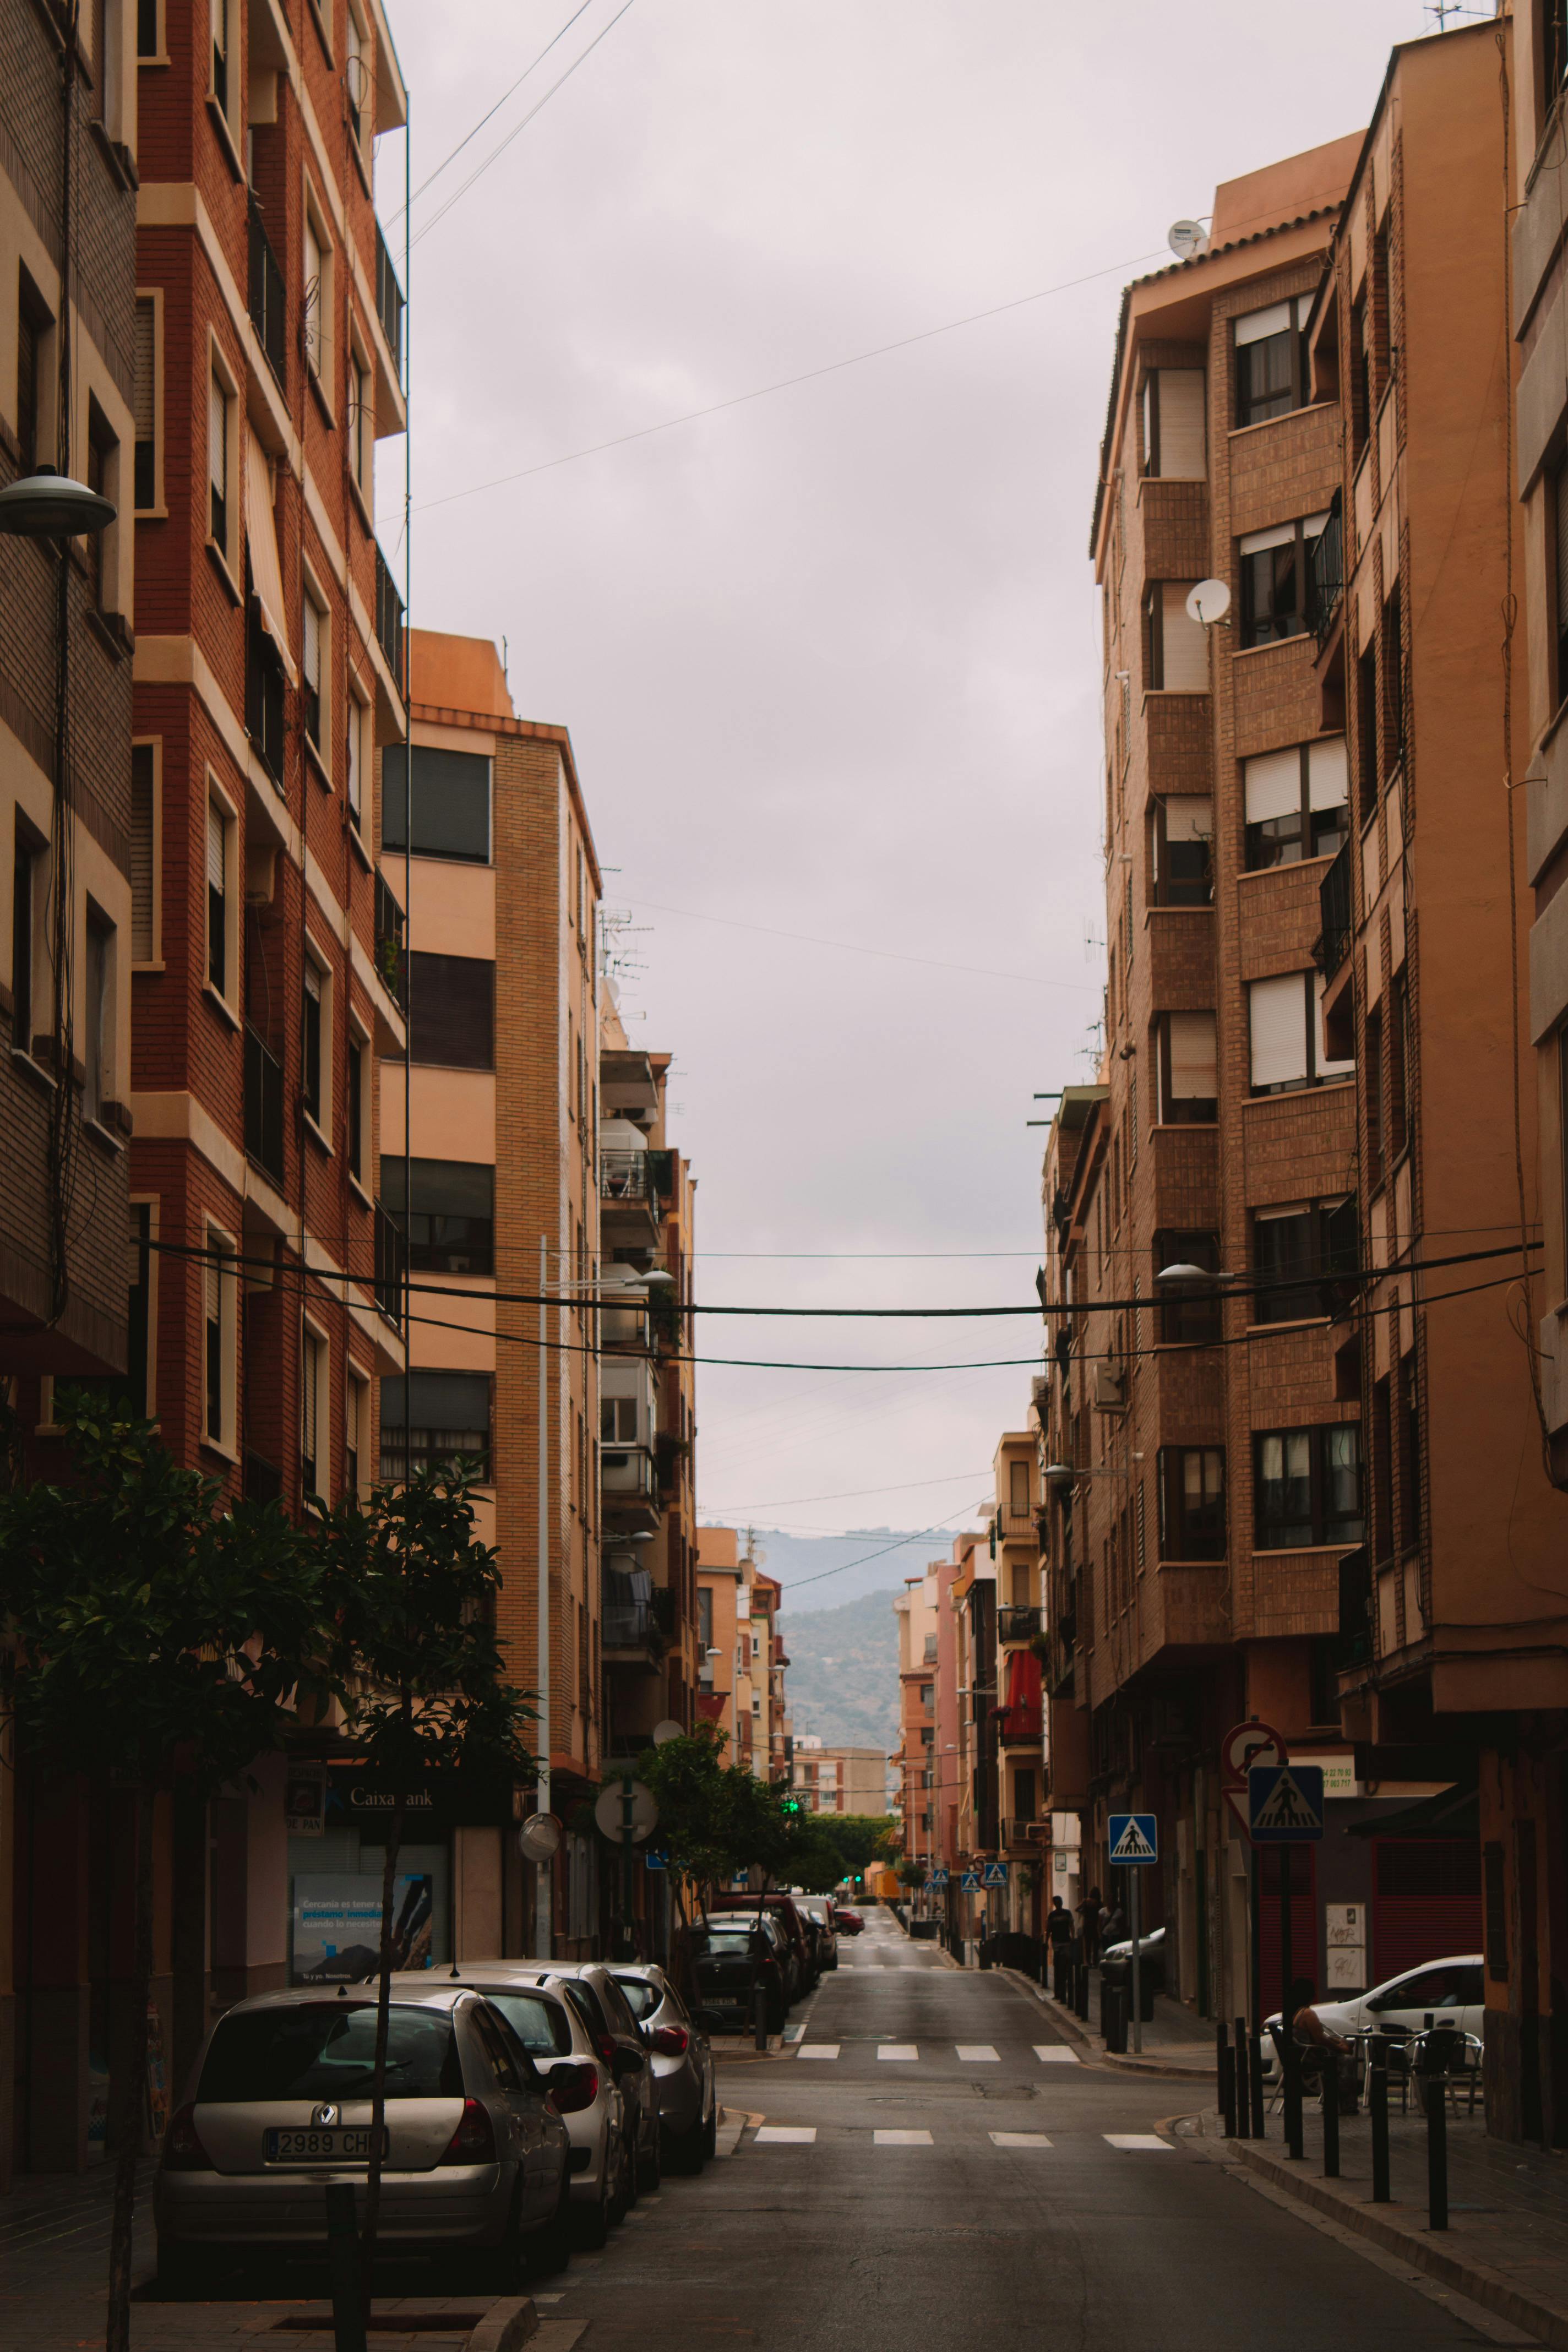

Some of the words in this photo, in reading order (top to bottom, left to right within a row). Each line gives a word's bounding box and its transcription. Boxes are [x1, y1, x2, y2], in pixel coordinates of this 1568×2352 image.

[351, 1787, 433, 1806] Caixaank
[286, 1819, 297, 1828] DE
[303, 1819, 320, 1829] PAN
[303, 1899, 339, 1908] Cercanía
[303, 1910, 344, 1919] préstamo
[347, 1910, 384, 1918] inmedia
[303, 1920, 335, 1928] cuando
[336, 1920, 344, 1928] lo
[346, 1920, 383, 1928] necesite
[281, 2133, 333, 2153] 2989
[343, 2133, 371, 2153] CH
